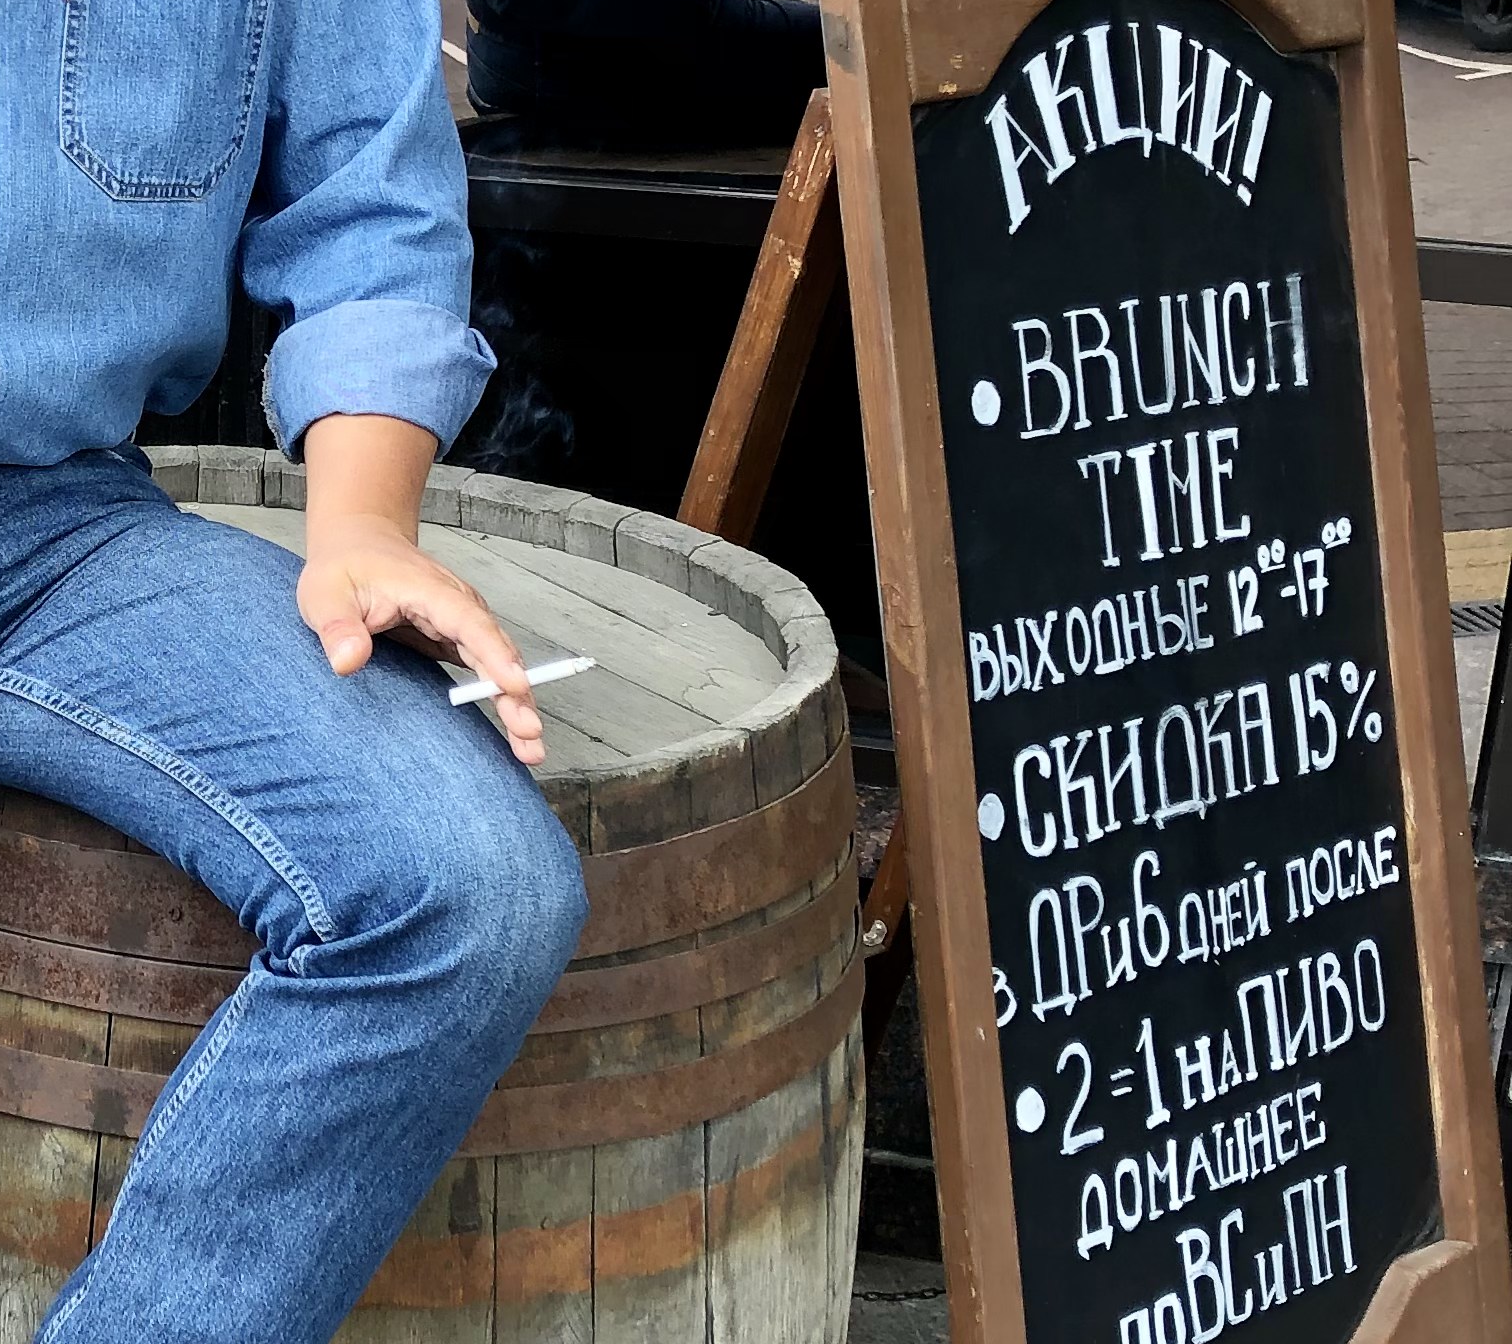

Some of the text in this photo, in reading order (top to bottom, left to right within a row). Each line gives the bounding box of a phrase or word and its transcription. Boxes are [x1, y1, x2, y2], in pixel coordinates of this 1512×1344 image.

[984, 22, 1272, 235] АКЦИИ!
[1012, 273, 1309, 439] BRUNCH
[1077, 427, 1251, 567] TIME
[969, 574, 1214, 702] ВЫХОДНЫЕ
[1013, 660, 1383, 857] СКИДКА 15%
[1285, 825, 1400, 924] ПОСЛЕ
[1077, 1082, 1326, 1261] ДОМАШНЕЕ
